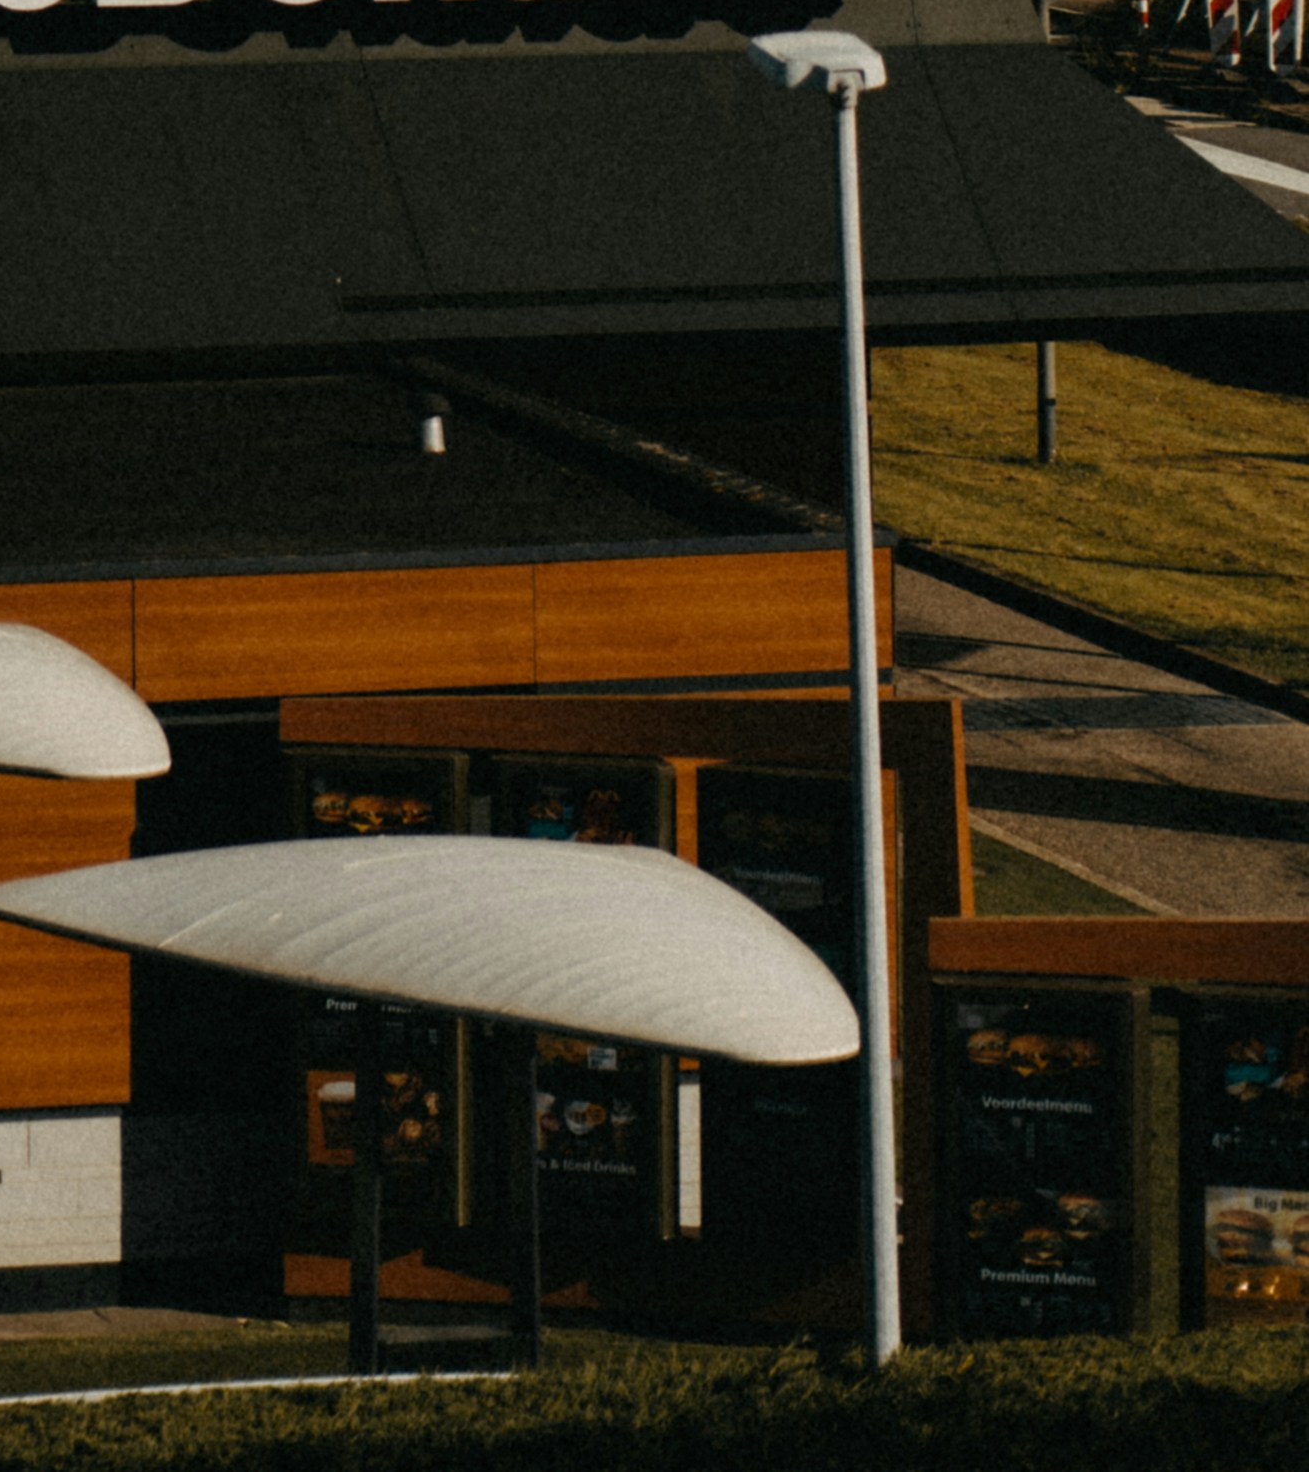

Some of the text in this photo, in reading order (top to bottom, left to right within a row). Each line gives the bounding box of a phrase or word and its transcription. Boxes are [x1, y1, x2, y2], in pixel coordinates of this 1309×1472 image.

[981, 1095, 1093, 1115] Voordeelmenu
[1254, 1196, 1278, 1212] Big
[980, 1267, 1097, 1287] Premium Menu
